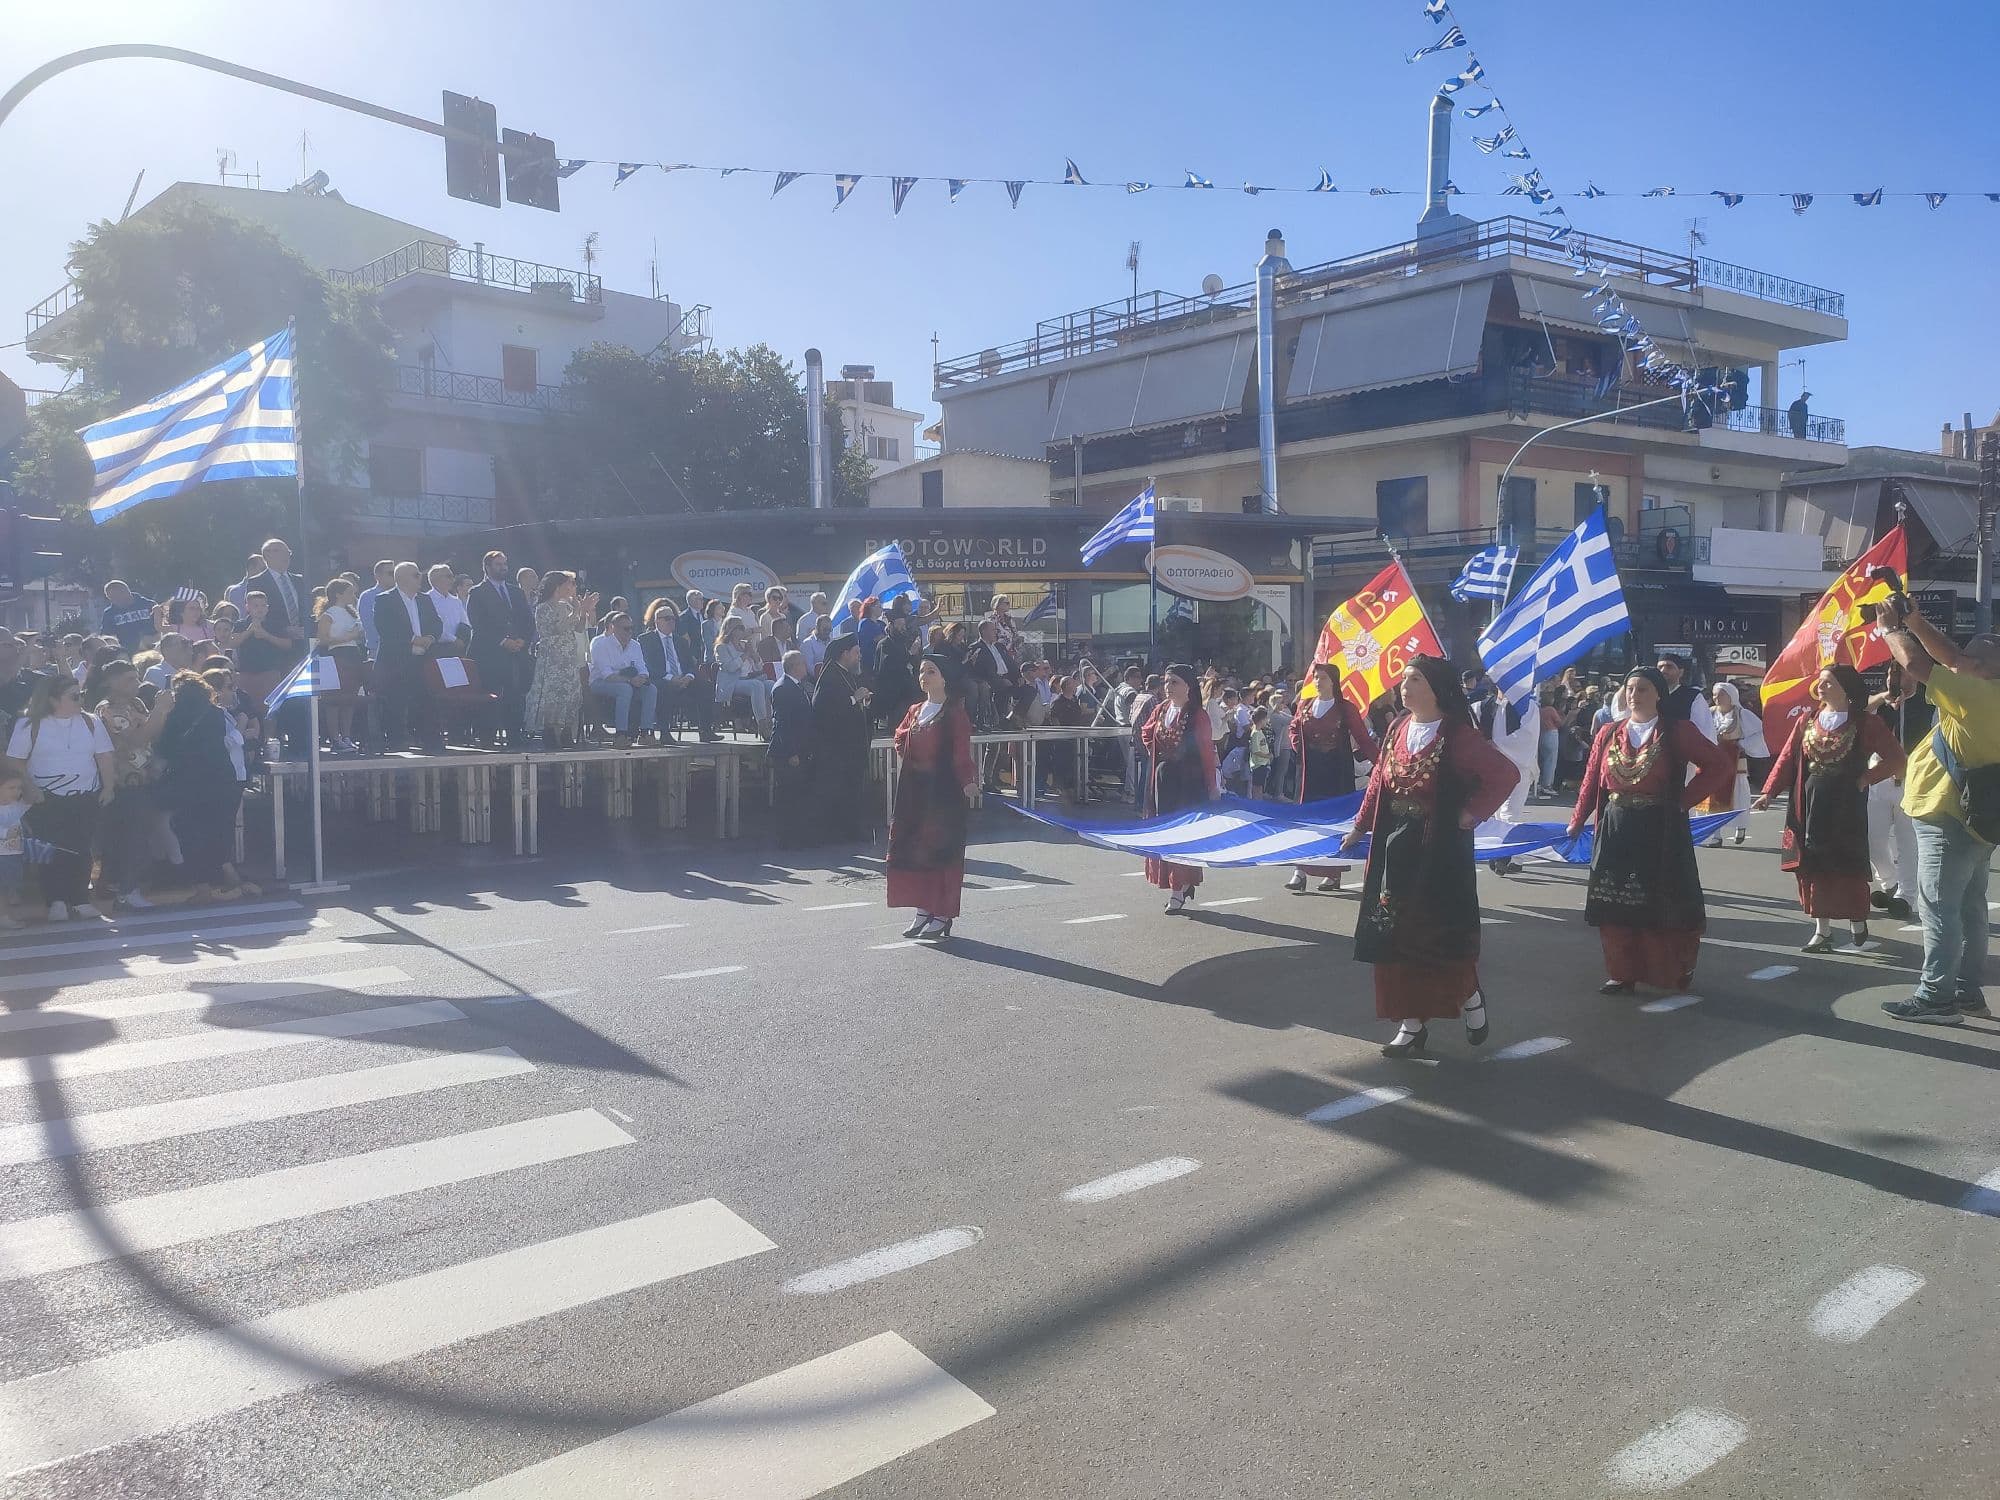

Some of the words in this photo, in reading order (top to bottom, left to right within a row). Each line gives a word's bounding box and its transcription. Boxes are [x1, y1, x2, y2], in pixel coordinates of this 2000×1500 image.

[916, 559, 924, 569] &
[927, 558, 960, 571] δώρα
[963, 557, 1046, 572] ξανθοπούλου
[688, 567, 751, 578] ΦΩΤΟΓΡΑΦΙΑ
[1166, 567, 1234, 579] ΦΩΤΟΓΡΑΦΕΙΟ
